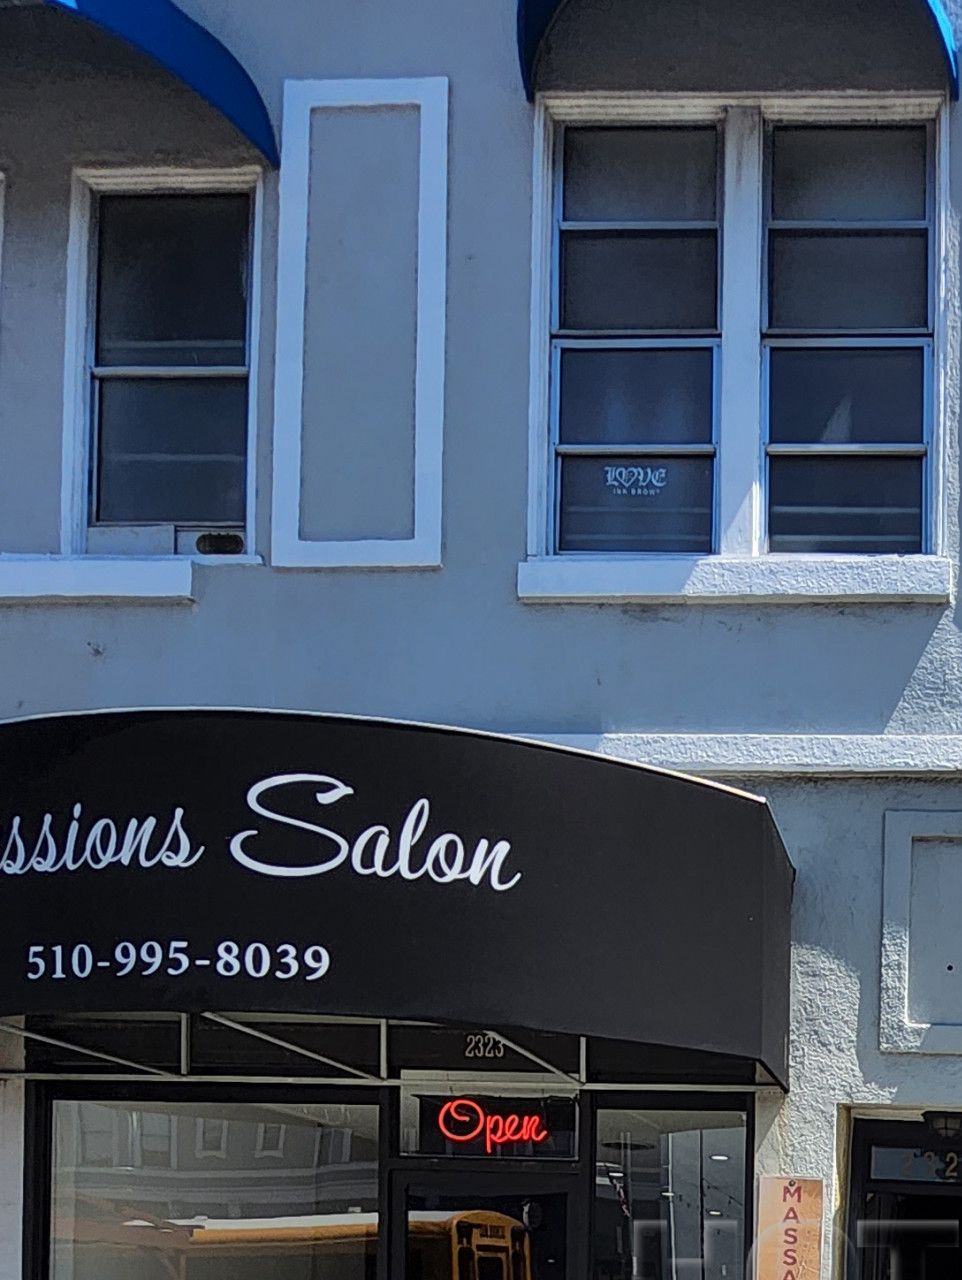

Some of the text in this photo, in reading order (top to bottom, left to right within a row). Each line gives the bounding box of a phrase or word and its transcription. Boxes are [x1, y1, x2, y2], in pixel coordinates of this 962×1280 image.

[604, 467, 666, 487] LOVE
[230, 773, 522, 891] Salon
[27, 941, 330, 980] 510-995-8039
[465, 1035, 504, 1057] 2323
[438, 1099, 548, 1154] Open
